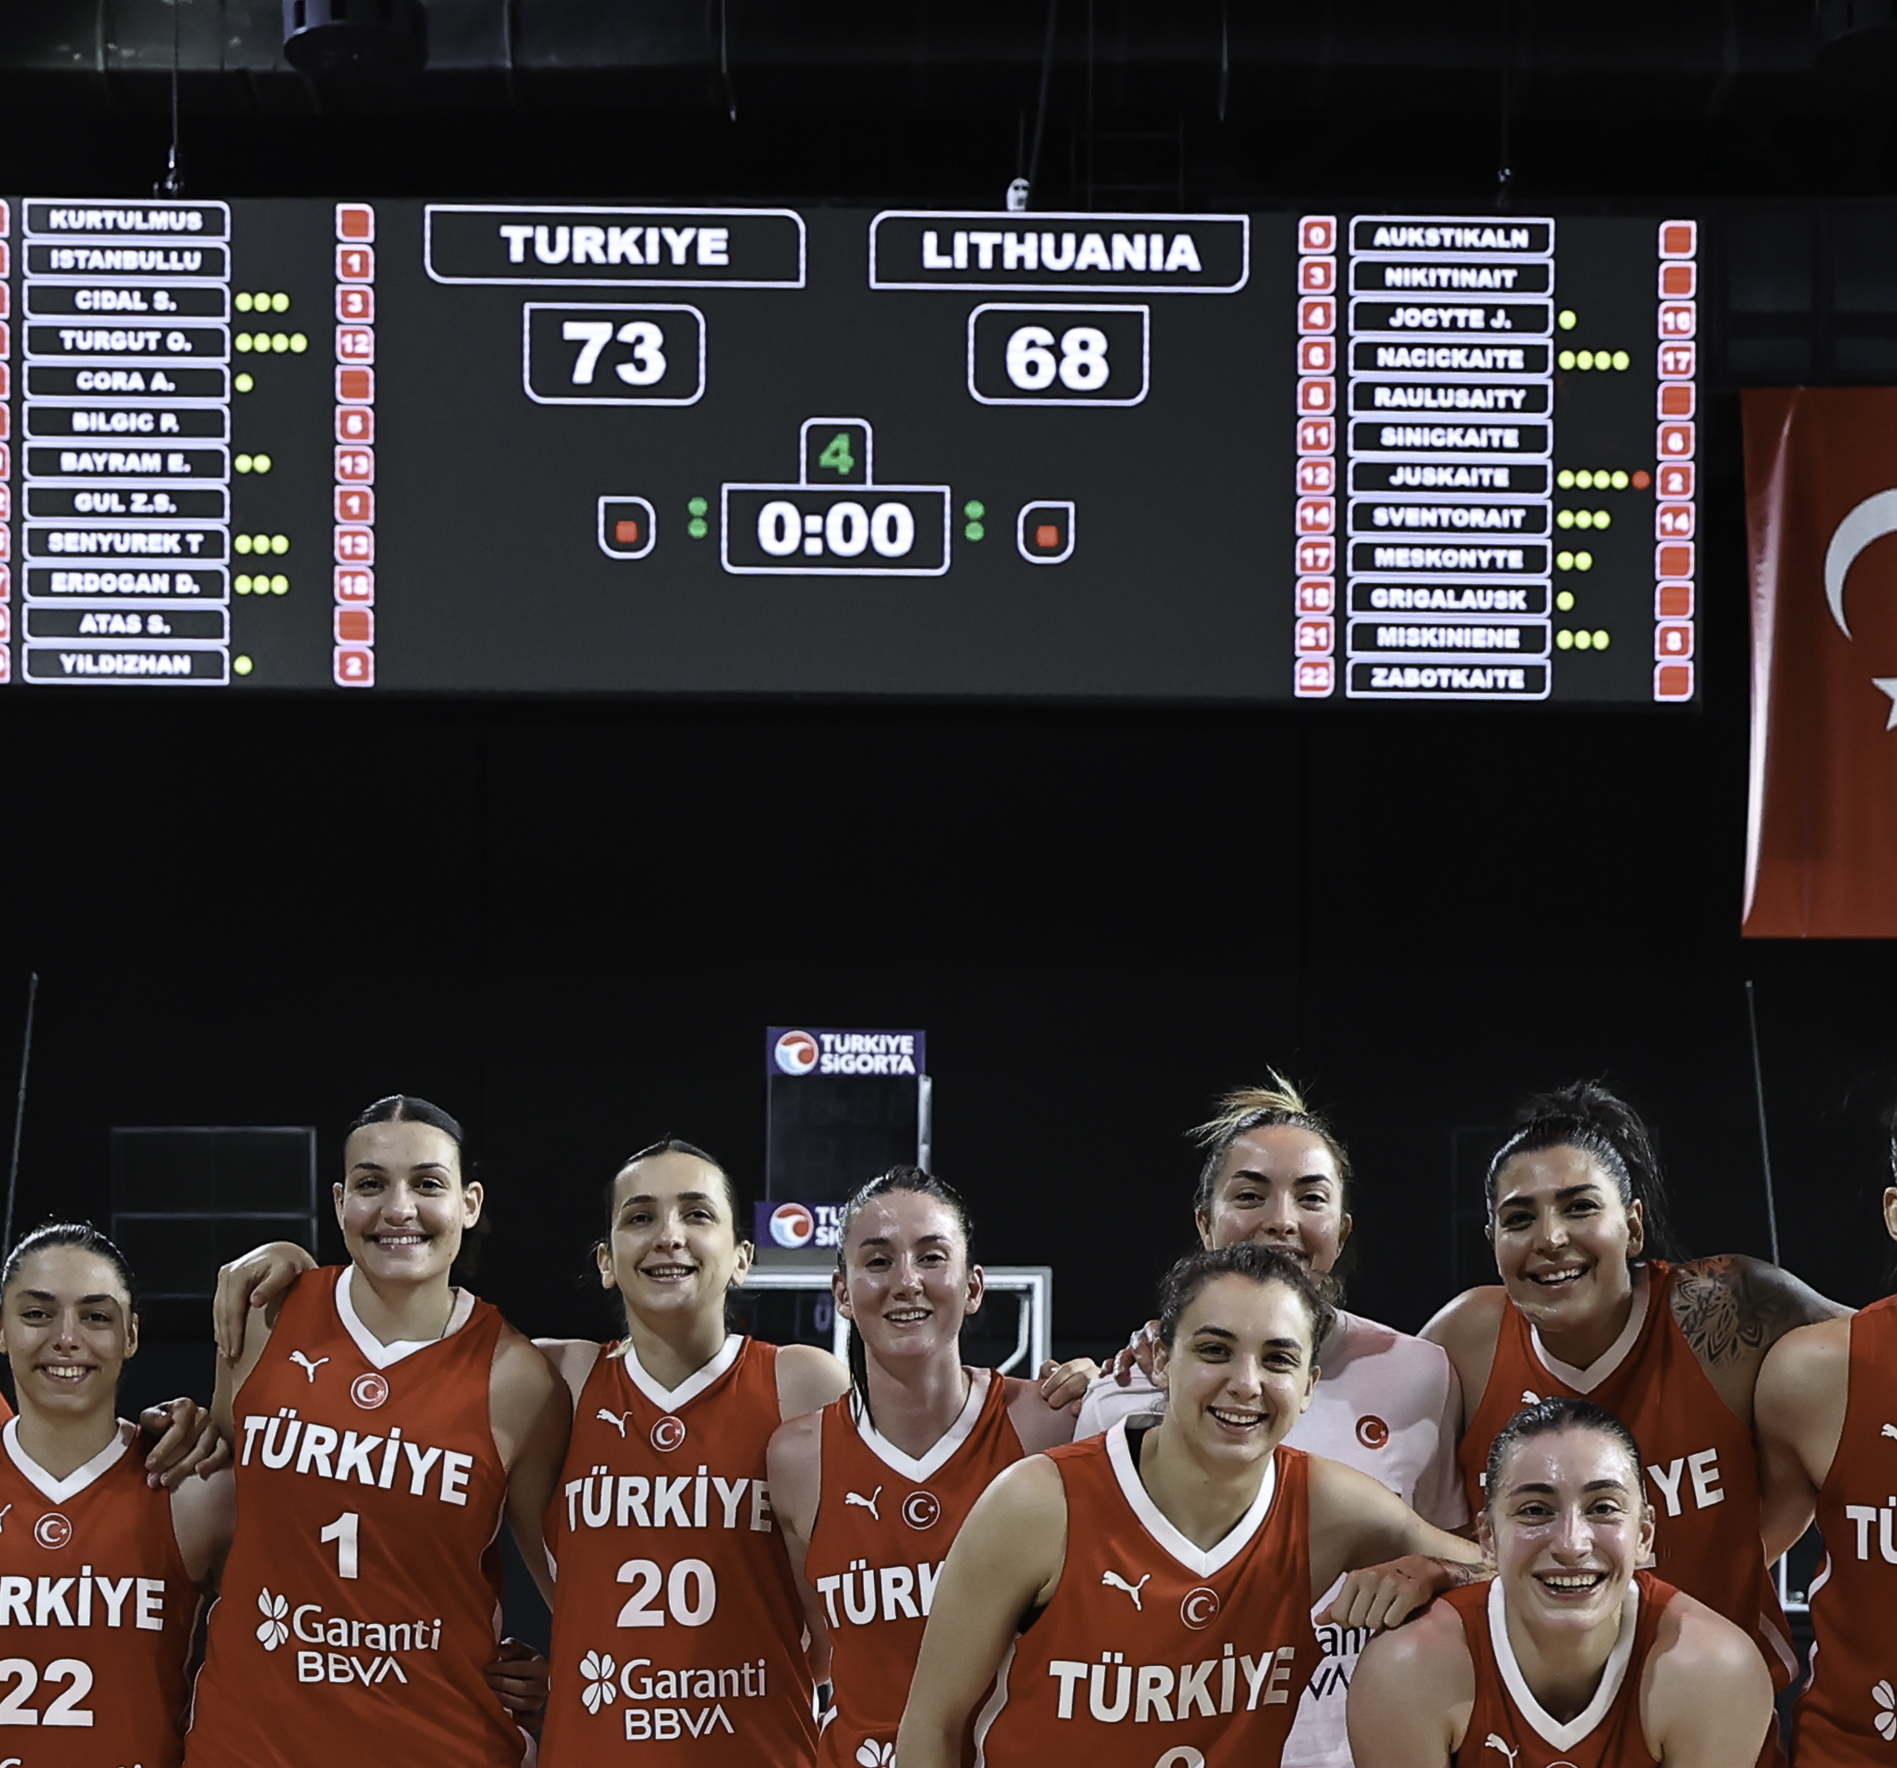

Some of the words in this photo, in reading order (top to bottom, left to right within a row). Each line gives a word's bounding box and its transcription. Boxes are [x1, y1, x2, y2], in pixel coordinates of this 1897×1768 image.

[50, 210, 202, 230] KURTULMUS
[500, 226, 728, 265] TURKIYE
[1309, 227, 1326, 245] 0
[1374, 228, 1528, 248] AUKSTIKALN
[51, 249, 201, 270] ISTANBULLU
[923, 232, 1201, 271] LITHUANIA
[1310, 267, 1325, 285] 3
[1385, 268, 1517, 288] NIKITINAIT
[75, 290, 148, 310] CIDAL
[153, 291, 176, 311] S.
[1309, 307, 1325, 326] 4
[1389, 308, 1484, 328] JOCYTE
[1490, 309, 1511, 328] J.
[59, 330, 161, 351] TURGUT
[167, 332, 192, 351] O.
[563, 322, 666, 385] 73
[1007, 327, 1109, 390] 68
[1377, 348, 1524, 369] NACICKAITE
[77, 371, 145, 390] CORA
[150, 372, 175, 391] A.
[1375, 387, 1526, 409] RAULUSAITY
[72, 412, 154, 431] BILGIC
[160, 413, 179, 432] P.
[1301, 426, 1329, 447] 11
[1381, 427, 1519, 447] SINICKAITE
[61, 452, 161, 472] BAYRAM
[168, 454, 191, 472] E.
[820, 434, 854, 474] 4
[1300, 466, 1330, 488] 12
[1389, 467, 1509, 487] JUSKAITE
[75, 493, 126, 512] GUL
[1300, 506, 1331, 528] 14
[1373, 507, 1526, 528] SVENTORAIT
[758, 502, 914, 557] 0:00
[48, 533, 181, 553] SENYUREK
[186, 534, 204, 553] T
[1300, 547, 1331, 569] 17
[1375, 548, 1523, 568] MESKONYTE
[51, 573, 169, 593] ERDOGAN
[175, 574, 200, 593] D.
[1371, 589, 1527, 610] GRIGALAUSK
[79, 614, 142, 633] ATAS
[147, 615, 171, 634] S.
[1299, 626, 1328, 648] 21
[1377, 627, 1520, 648] MISKINIENE
[60, 654, 191, 674] YILDIZHAN
[1299, 666, 1330, 687] 22
[1371, 668, 1524, 689] ZABOTKAITE
[242, 1408, 473, 1505] TÜRKİYE
[565, 1465, 771, 1531] TÜRKİYE
[321, 1512, 358, 1578] 1
[617, 1559, 716, 1627] 20
[818, 1559, 946, 1630] TÜRK
[293, 1605, 441, 1651] Garanti
[298, 1651, 407, 1686] BBVA
[621, 1659, 765, 1699] Garanti
[1049, 1644, 1294, 1722] TÜRKİYE
[625, 1704, 734, 1740] BBVA
